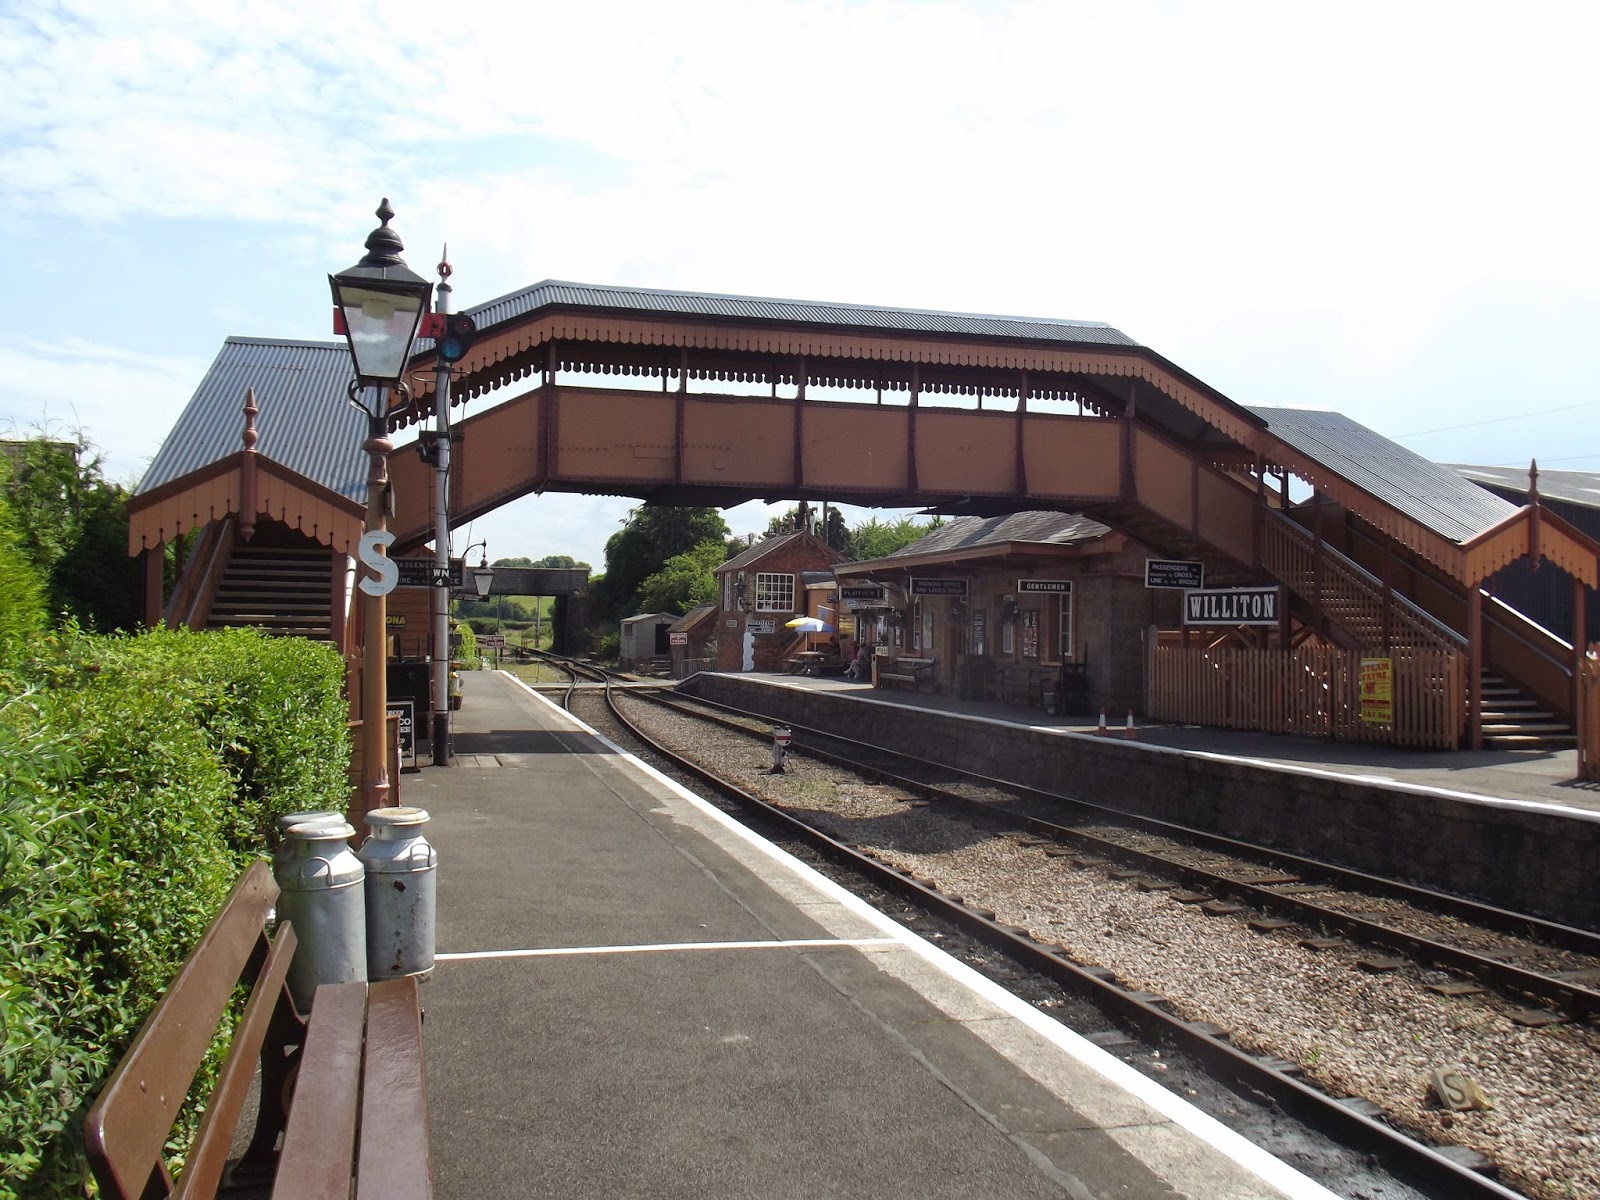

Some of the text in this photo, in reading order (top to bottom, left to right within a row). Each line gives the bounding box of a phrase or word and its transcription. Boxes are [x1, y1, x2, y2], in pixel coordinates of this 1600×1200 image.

[358, 530, 399, 596] S
[433, 569, 449, 577] WN
[435, 578, 443, 586] 4
[1190, 594, 1274, 618] WILLITON
[386, 616, 406, 624] ONA
[1362, 662, 1389, 671] STEAM
[1362, 672, 1387, 680] FAYRE
[1443, 1072, 1466, 1105] S
